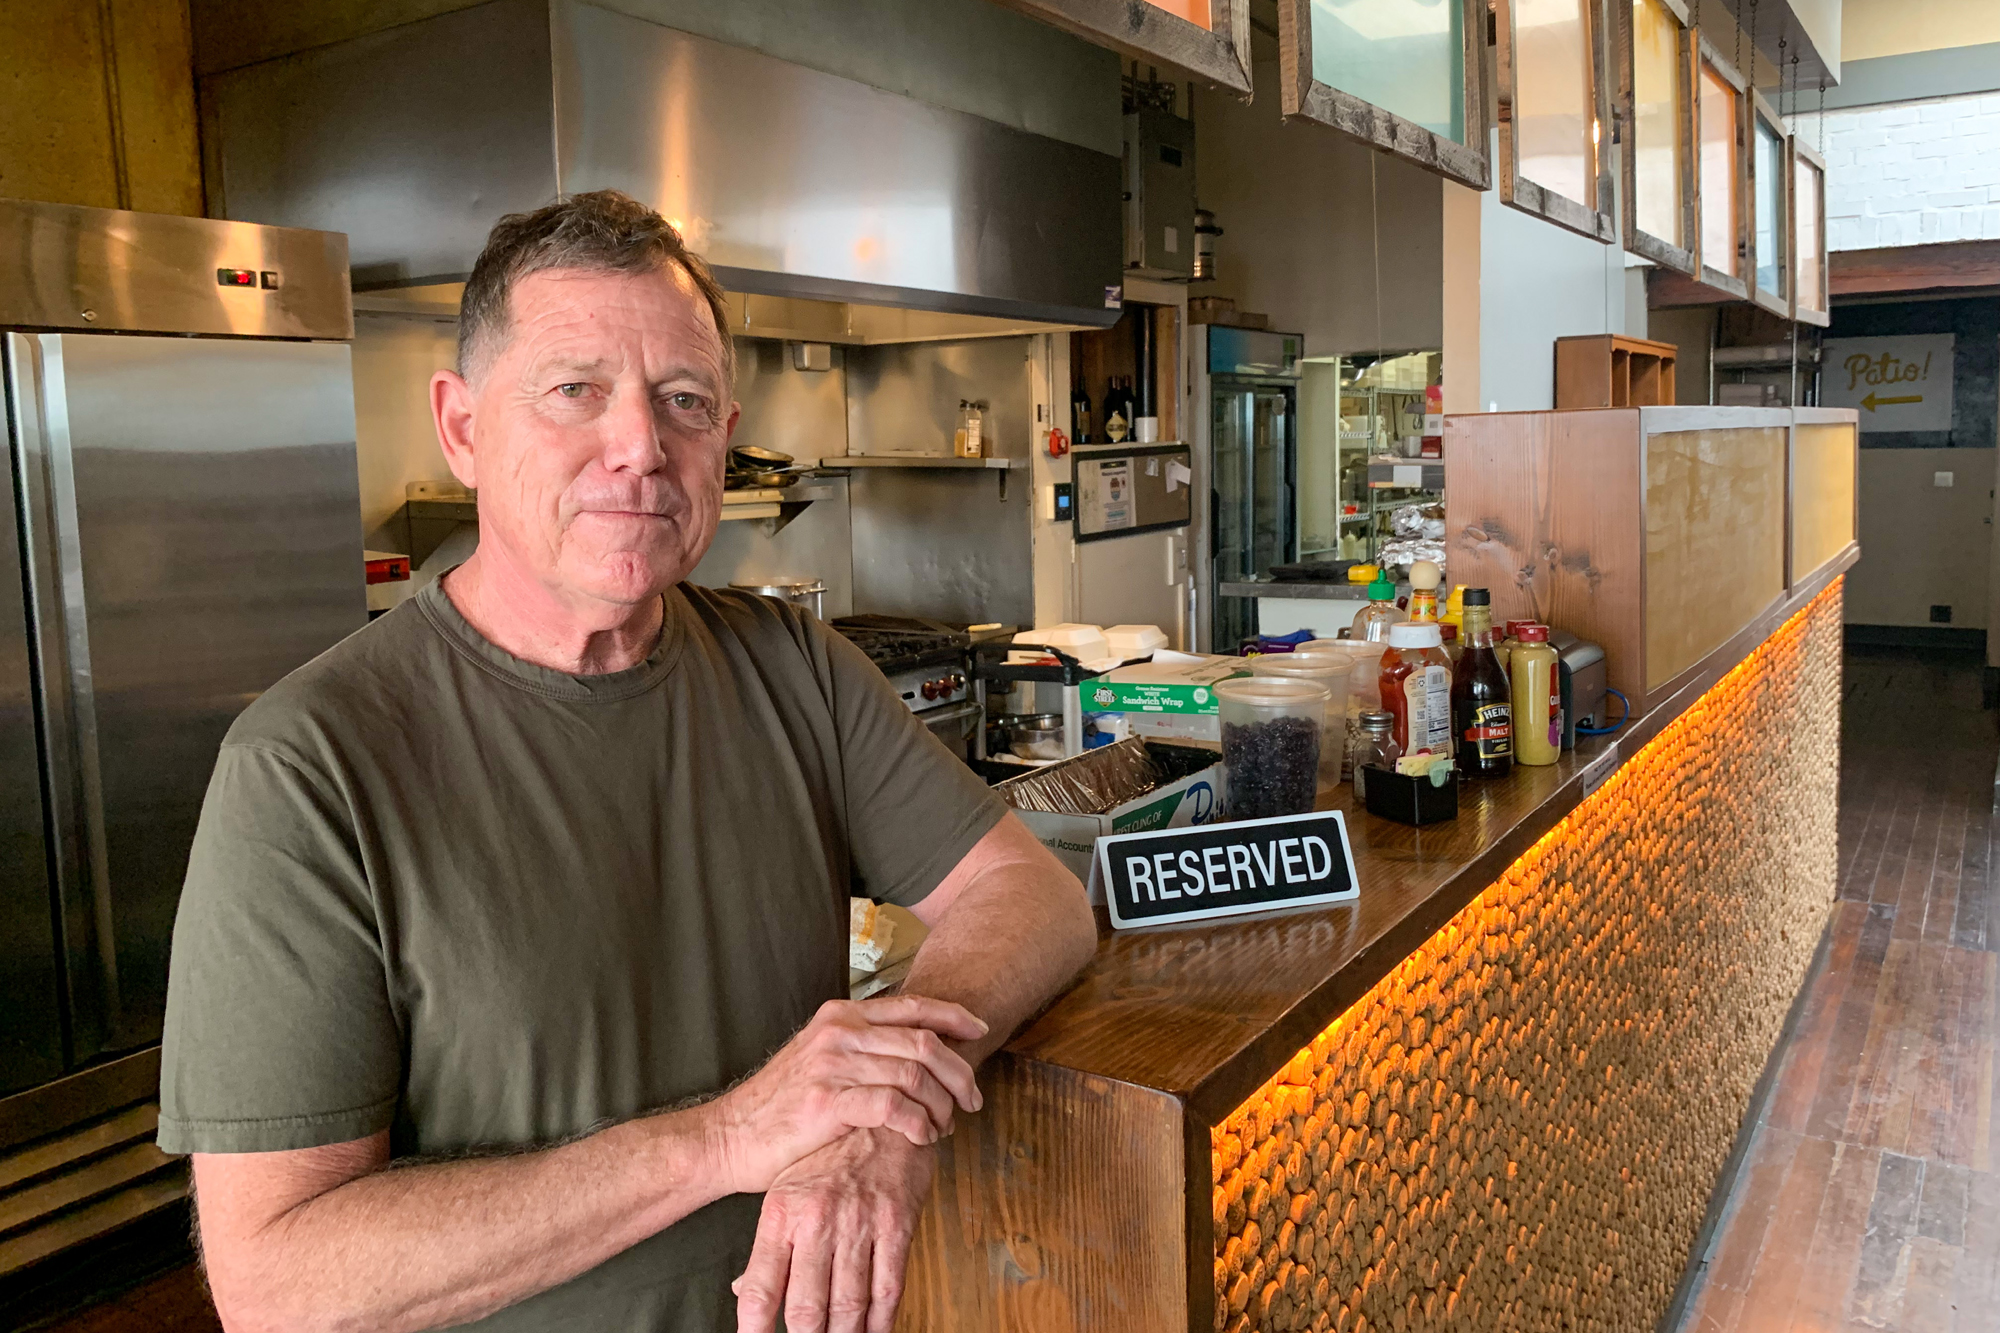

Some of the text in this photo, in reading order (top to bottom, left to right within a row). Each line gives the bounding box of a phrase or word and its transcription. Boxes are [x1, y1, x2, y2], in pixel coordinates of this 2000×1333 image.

[1843, 351, 1932, 391] Patio!
[1122, 695, 1160, 705] Sandwich
[1161, 697, 1184, 708] Wrap
[1483, 707, 1510, 720] HEINZ
[1488, 727, 1509, 737] MALT
[1131, 814, 1152, 832] CLING
[1152, 810, 1163, 823] OF
[1125, 835, 1333, 904] RESERVED
